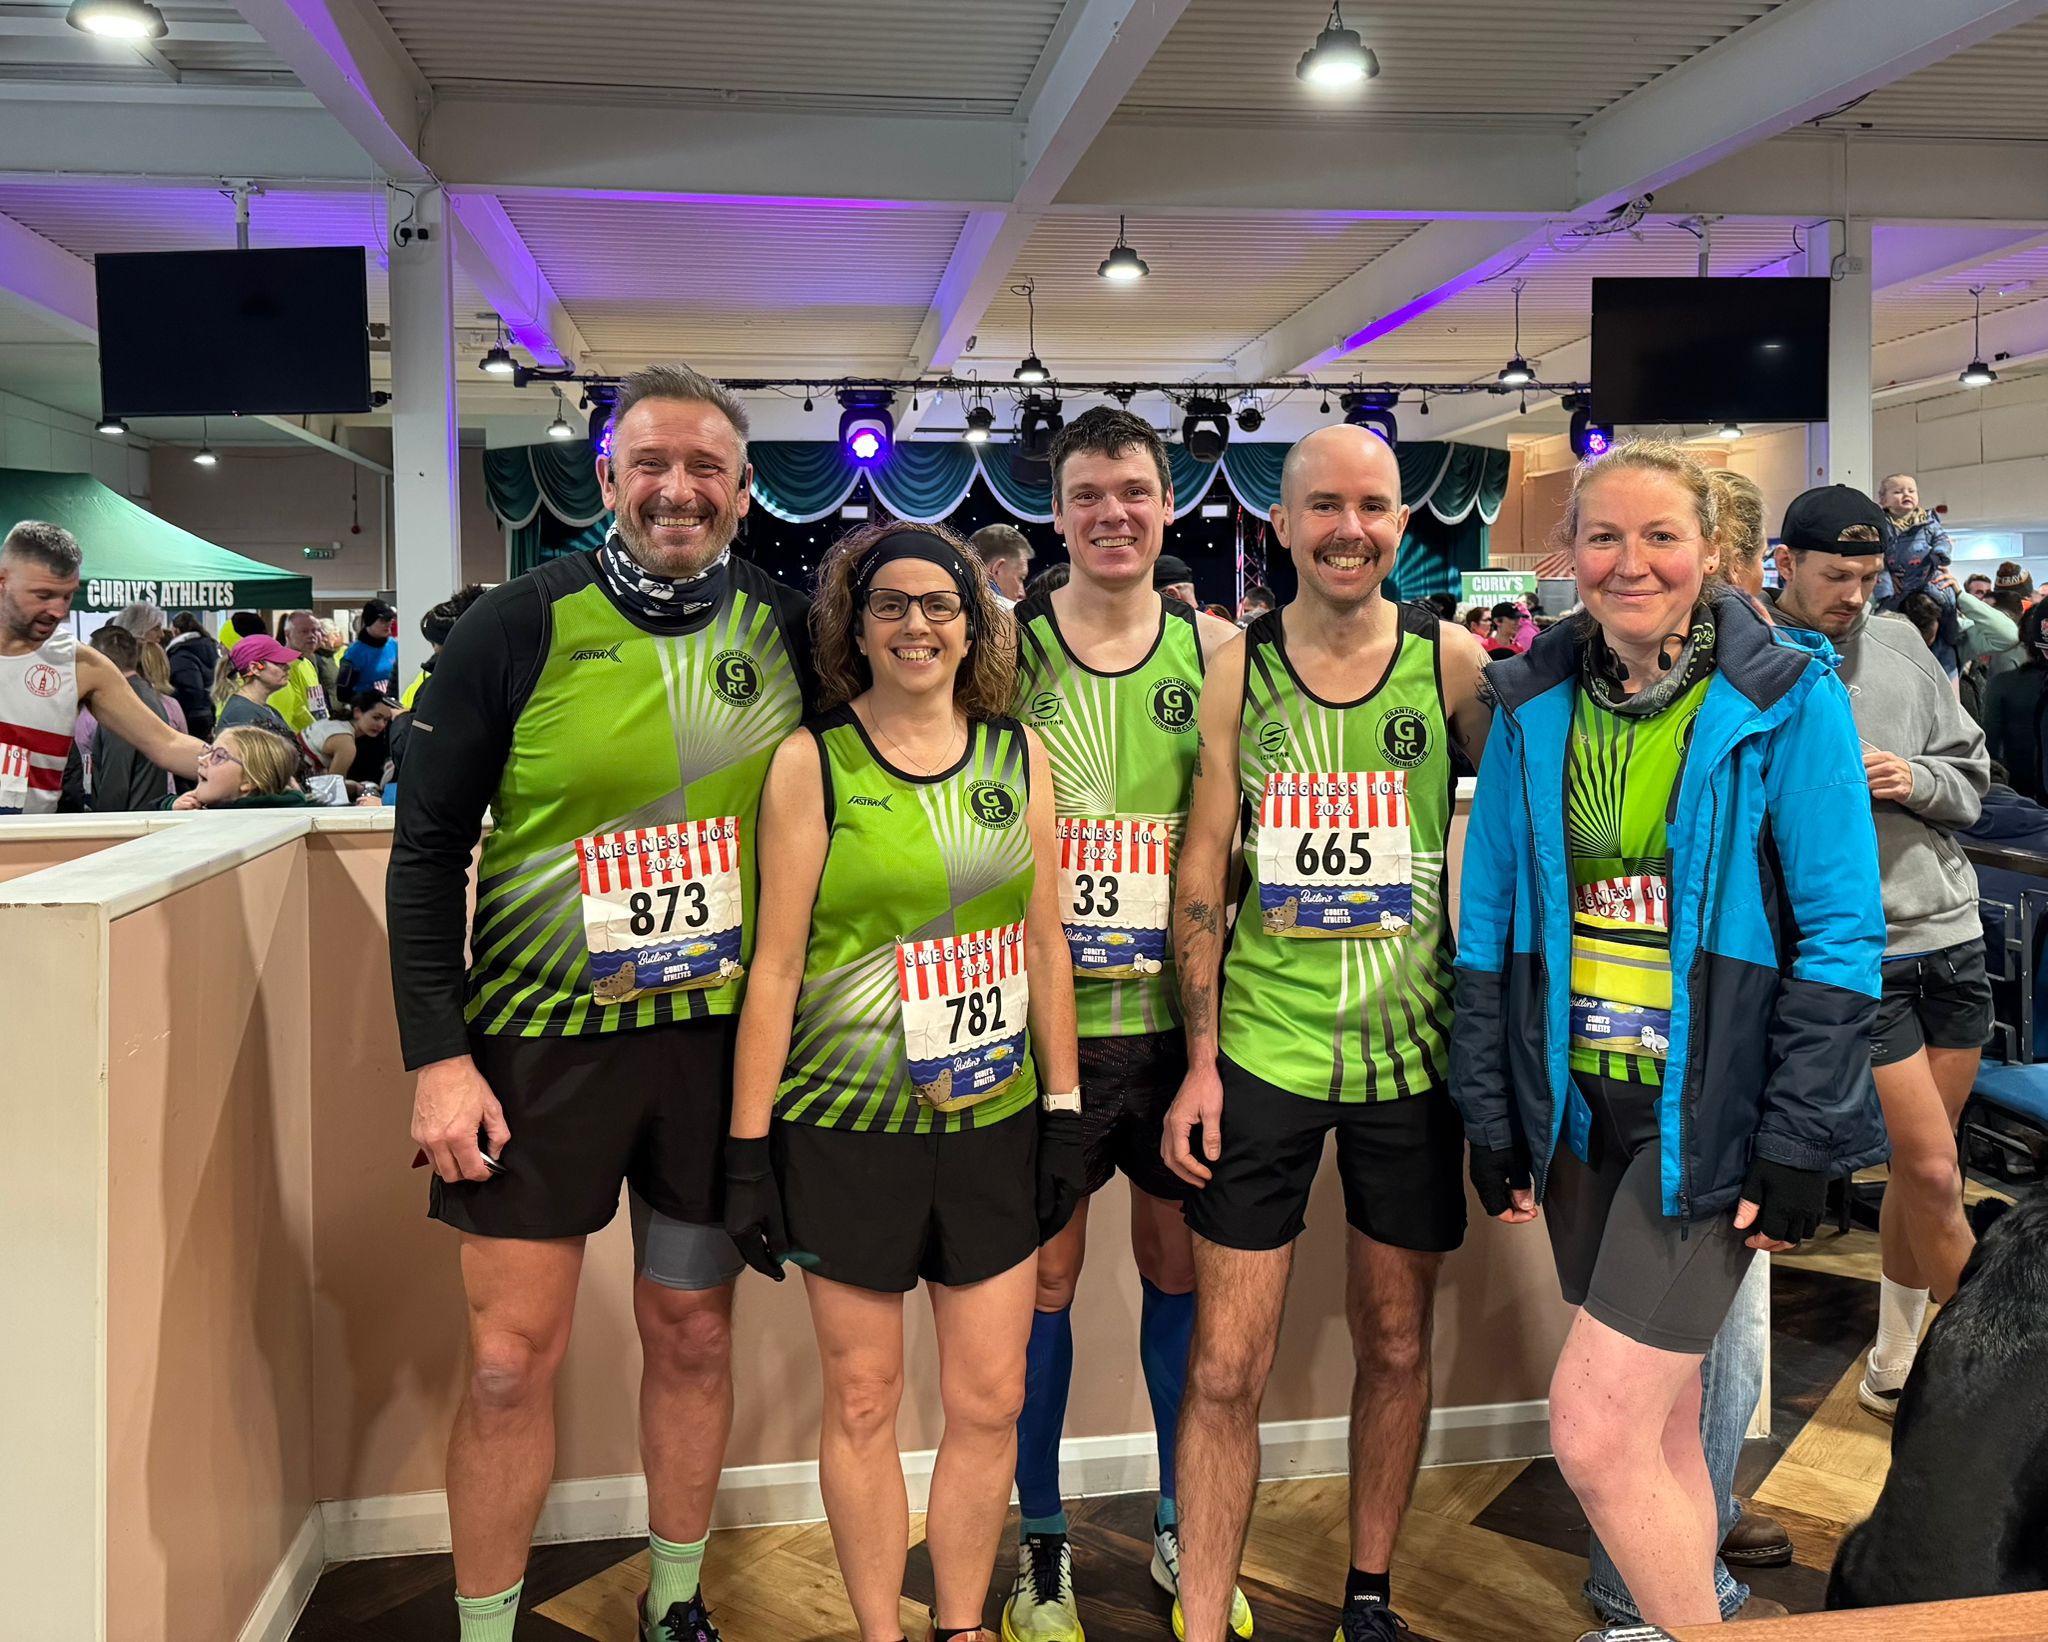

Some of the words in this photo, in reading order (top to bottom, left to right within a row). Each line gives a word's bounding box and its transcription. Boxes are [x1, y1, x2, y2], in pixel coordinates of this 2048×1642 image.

[87, 579, 157, 607] CURLY'S
[160, 581, 234, 607] ATHLETES
[1472, 576, 1524, 592] CURLY'S
[716, 650, 754, 664] GRANTHAM
[725, 658, 746, 682] G
[726, 682, 750, 696] RC
[1154, 679, 1191, 692] GRANTHAM
[715, 688, 747, 705] RUNNING
[746, 691, 761, 705] CLUB
[1163, 686, 1183, 708] G
[1163, 708, 1186, 722] RC
[1385, 707, 1426, 722] GRANTHAM
[1152, 715, 1182, 733] RUNNING
[1181, 718, 1196, 732] CLUB
[1394, 717, 1415, 741] G
[1381, 748, 1414, 767] RUNNING
[1413, 750, 1428, 765] CLUB
[1394, 741, 1418, 756] RC
[969, 781, 1005, 792] GRANTHAM
[1268, 781, 1358, 797] SKEGNESS
[1370, 780, 1403, 796] 10K
[978, 788, 1000, 808] G
[982, 806, 1007, 820] RC
[1315, 802, 1354, 816] 2026
[973, 815, 1006, 829] RUNNING
[1005, 812, 1018, 827] CLUB
[1056, 825, 1123, 841] KEGNESS
[586, 833, 690, 862] SKEGNESS
[701, 824, 734, 844] 10K
[1082, 846, 1117, 861] 2026
[1296, 832, 1372, 876] 665
[646, 854, 687, 874] 2026
[1073, 874, 1119, 917] 33
[1577, 886, 1632, 910] EGNESS
[1645, 885, 1667, 901] 10
[630, 882, 709, 936] 873
[905, 938, 992, 967] SKEGNESS
[960, 959, 991, 979] 2026
[946, 986, 1006, 1044] 782
